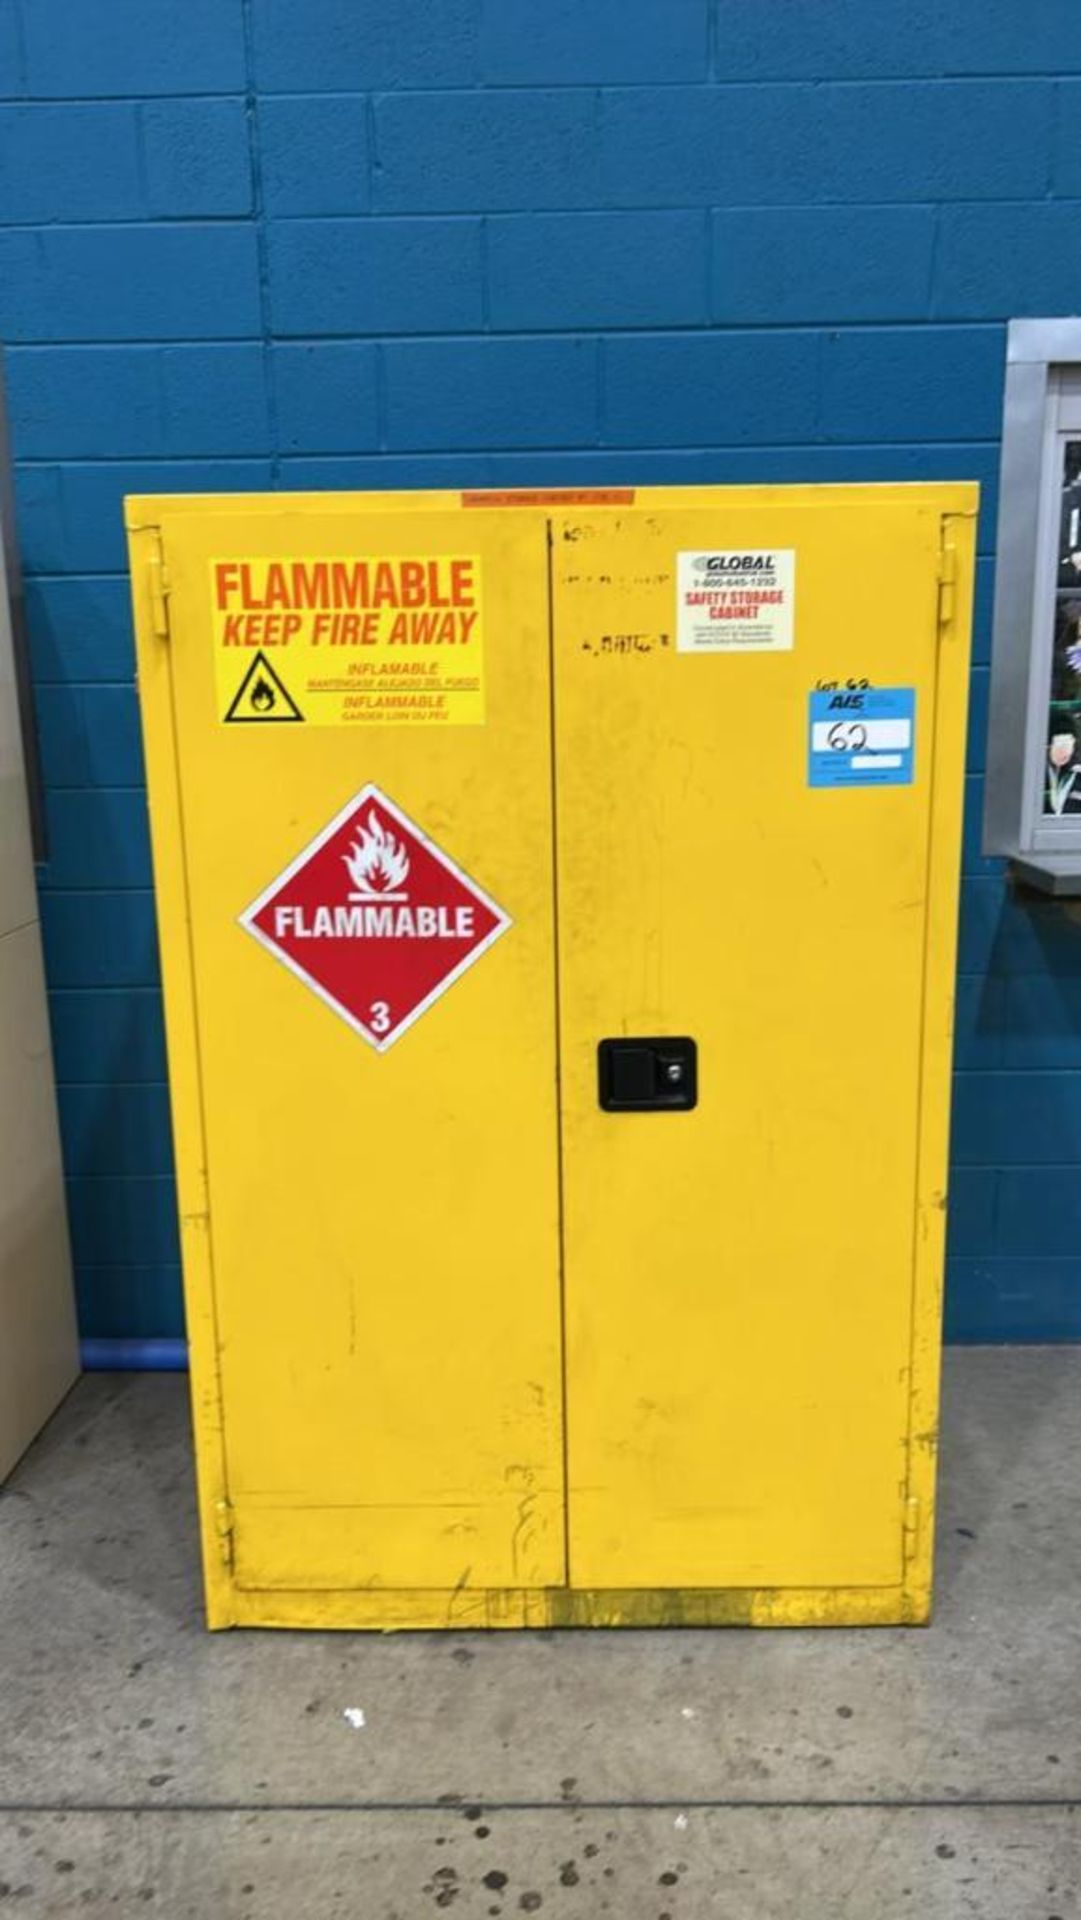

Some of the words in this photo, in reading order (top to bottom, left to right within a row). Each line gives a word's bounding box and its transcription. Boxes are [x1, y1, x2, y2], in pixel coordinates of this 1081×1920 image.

[706, 555, 775, 570] GLOBAL
[215, 561, 475, 610] FLAMMABLE
[686, 591, 728, 605] SAFETY
[730, 590, 783, 604] STORAGE
[709, 606, 759, 619] CABINET
[223, 614, 303, 647] KEEP
[311, 613, 380, 646] FIRE
[388, 612, 478, 645] AWAY
[347, 662, 439, 676] INFLAMABLE
[343, 695, 446, 708] INFLAMMABLE
[828, 693, 865, 710] AIS
[828, 722, 878, 755] 62
[274, 906, 475, 938] FLAMMABLE
[369, 1001, 390, 1032] 3
